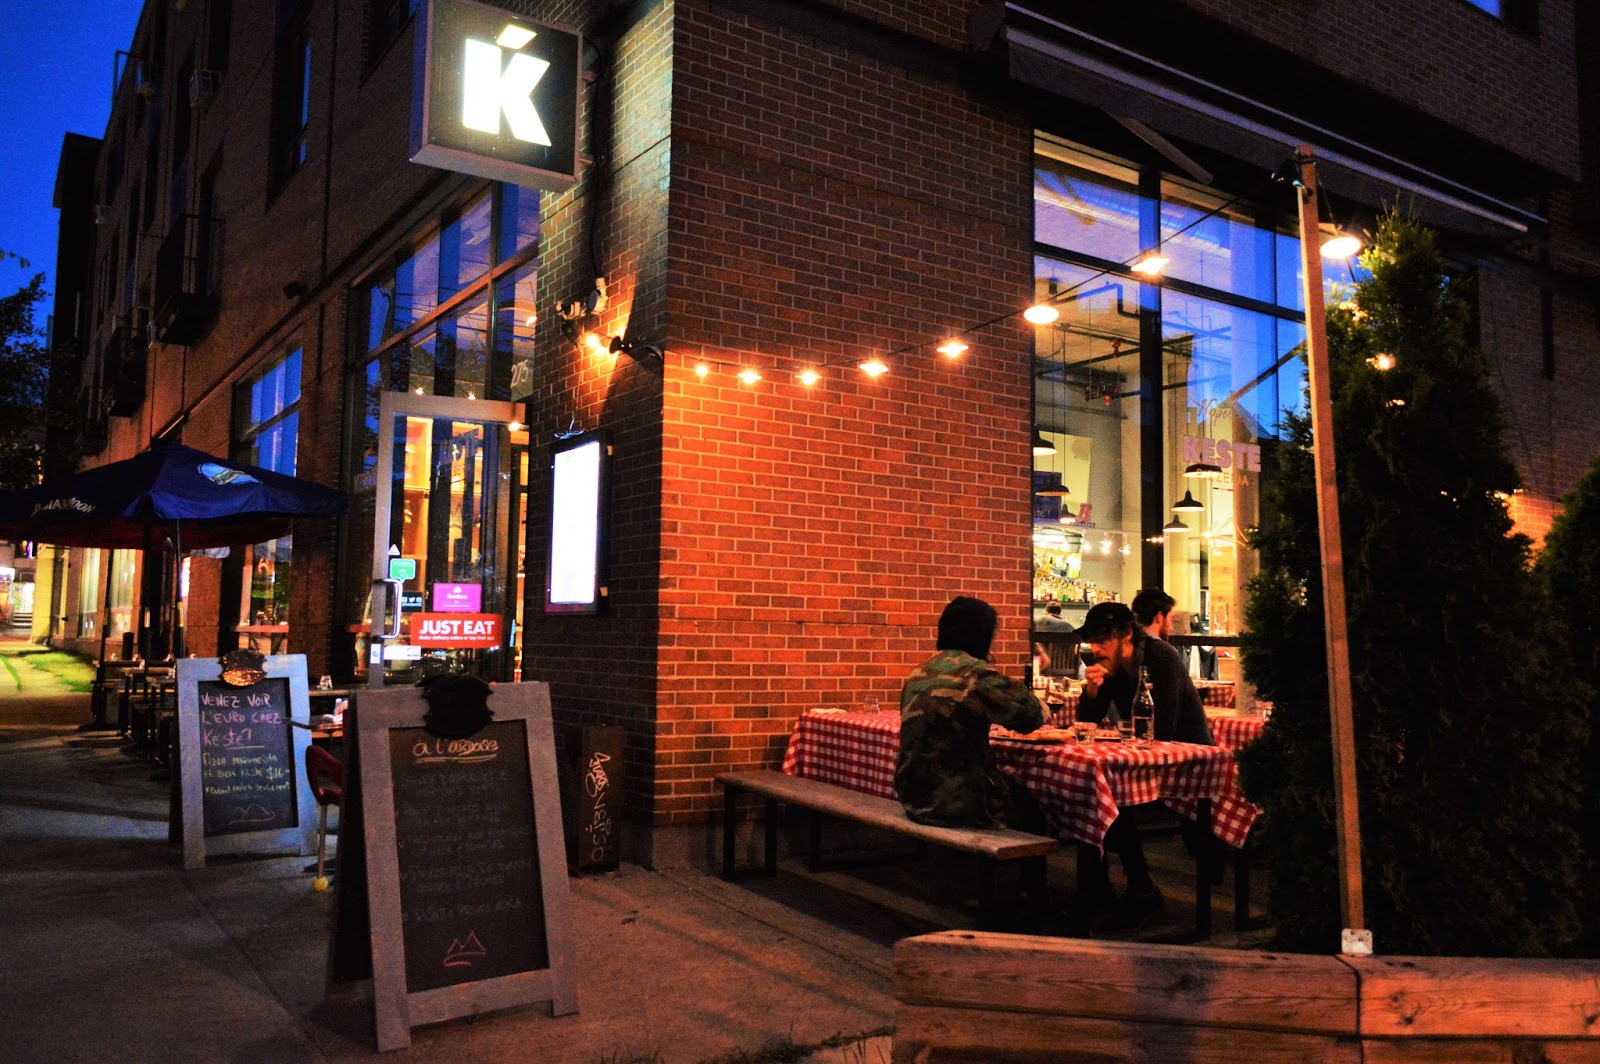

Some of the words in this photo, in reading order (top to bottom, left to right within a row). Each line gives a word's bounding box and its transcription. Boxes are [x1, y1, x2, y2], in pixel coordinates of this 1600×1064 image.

[510, 356, 528, 388] 275
[419, 620, 461, 635] JUST
[464, 620, 495, 635] EAT
[201, 692, 240, 708] VENEZ
[247, 693, 271, 708] VOIR
[202, 710, 245, 724] L'EURO
